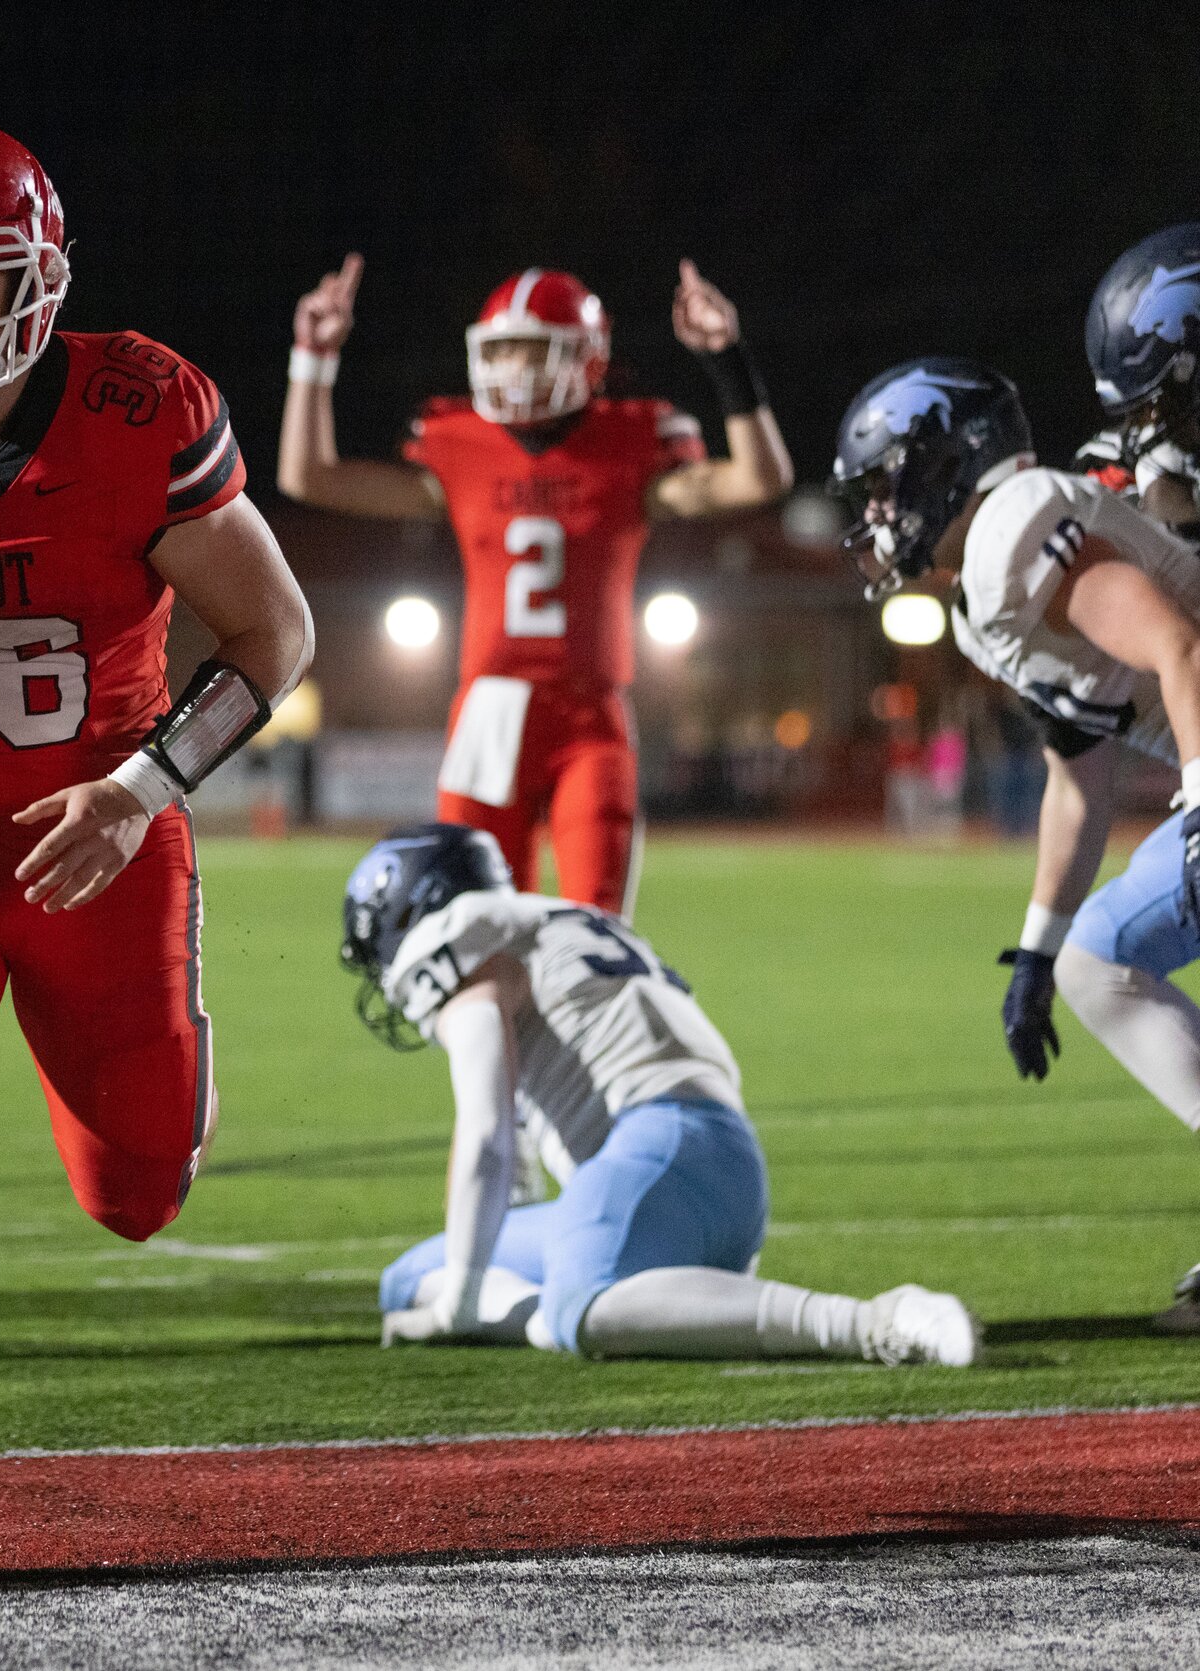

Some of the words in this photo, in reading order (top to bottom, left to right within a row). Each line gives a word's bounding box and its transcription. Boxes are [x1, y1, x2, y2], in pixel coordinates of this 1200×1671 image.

[82, 335, 181, 427] 36
[504, 515, 566, 637] 2
[415, 942, 461, 1008] 37
